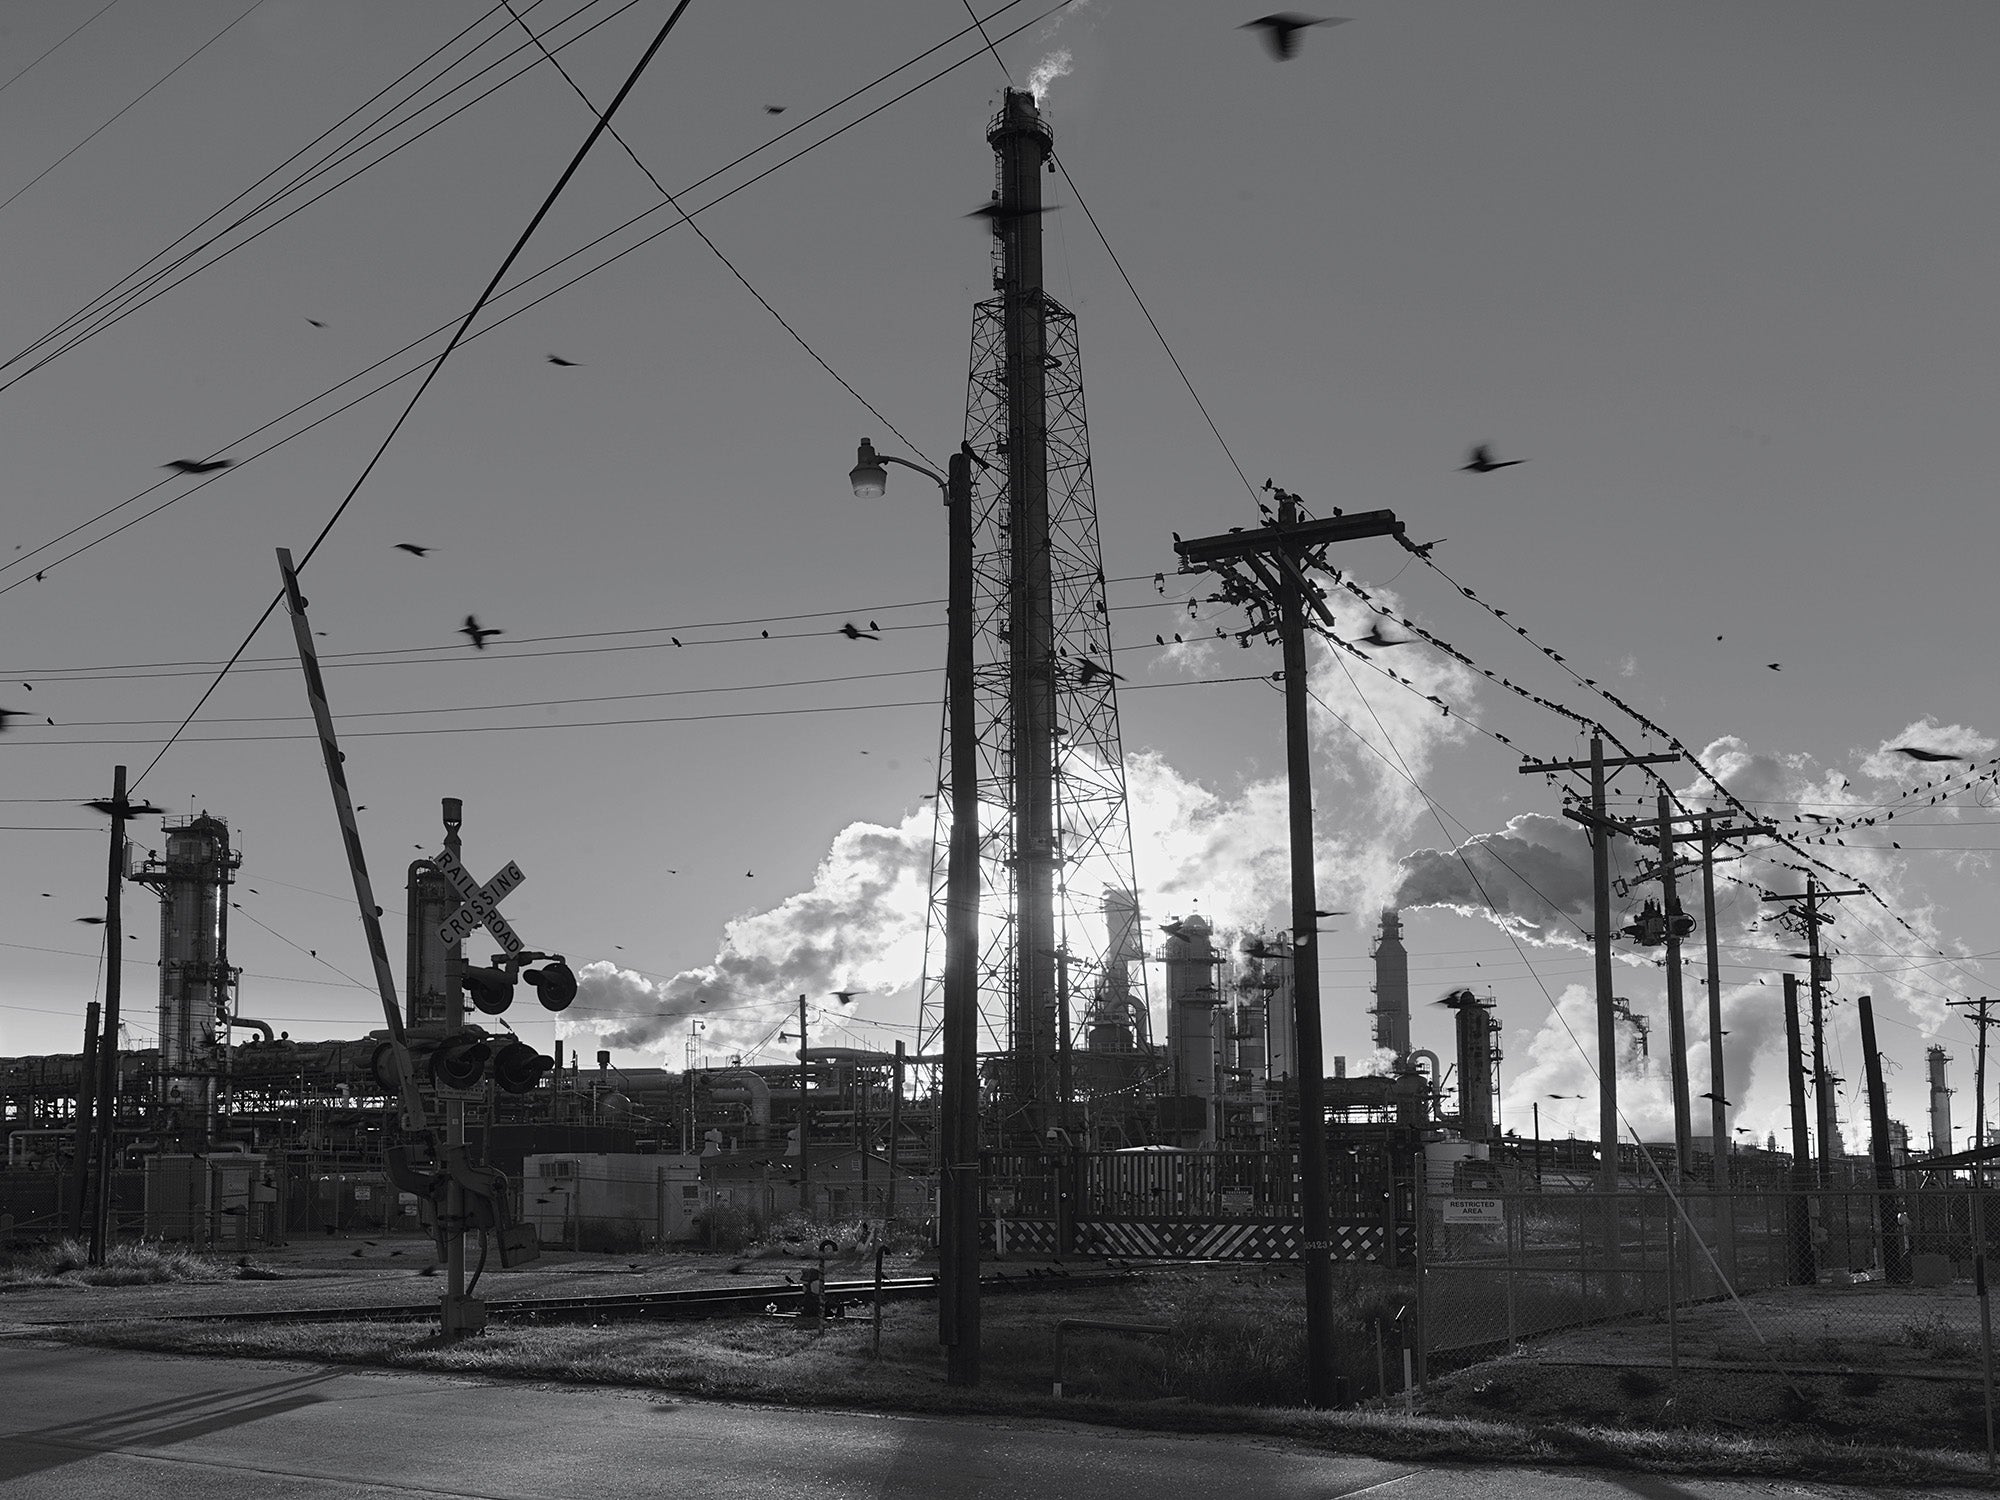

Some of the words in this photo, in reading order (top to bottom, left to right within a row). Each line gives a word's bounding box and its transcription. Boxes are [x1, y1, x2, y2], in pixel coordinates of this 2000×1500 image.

[439, 852, 473, 899] RAIL
[484, 910, 519, 952] ROAD
[440, 866, 520, 943] CROSSING
